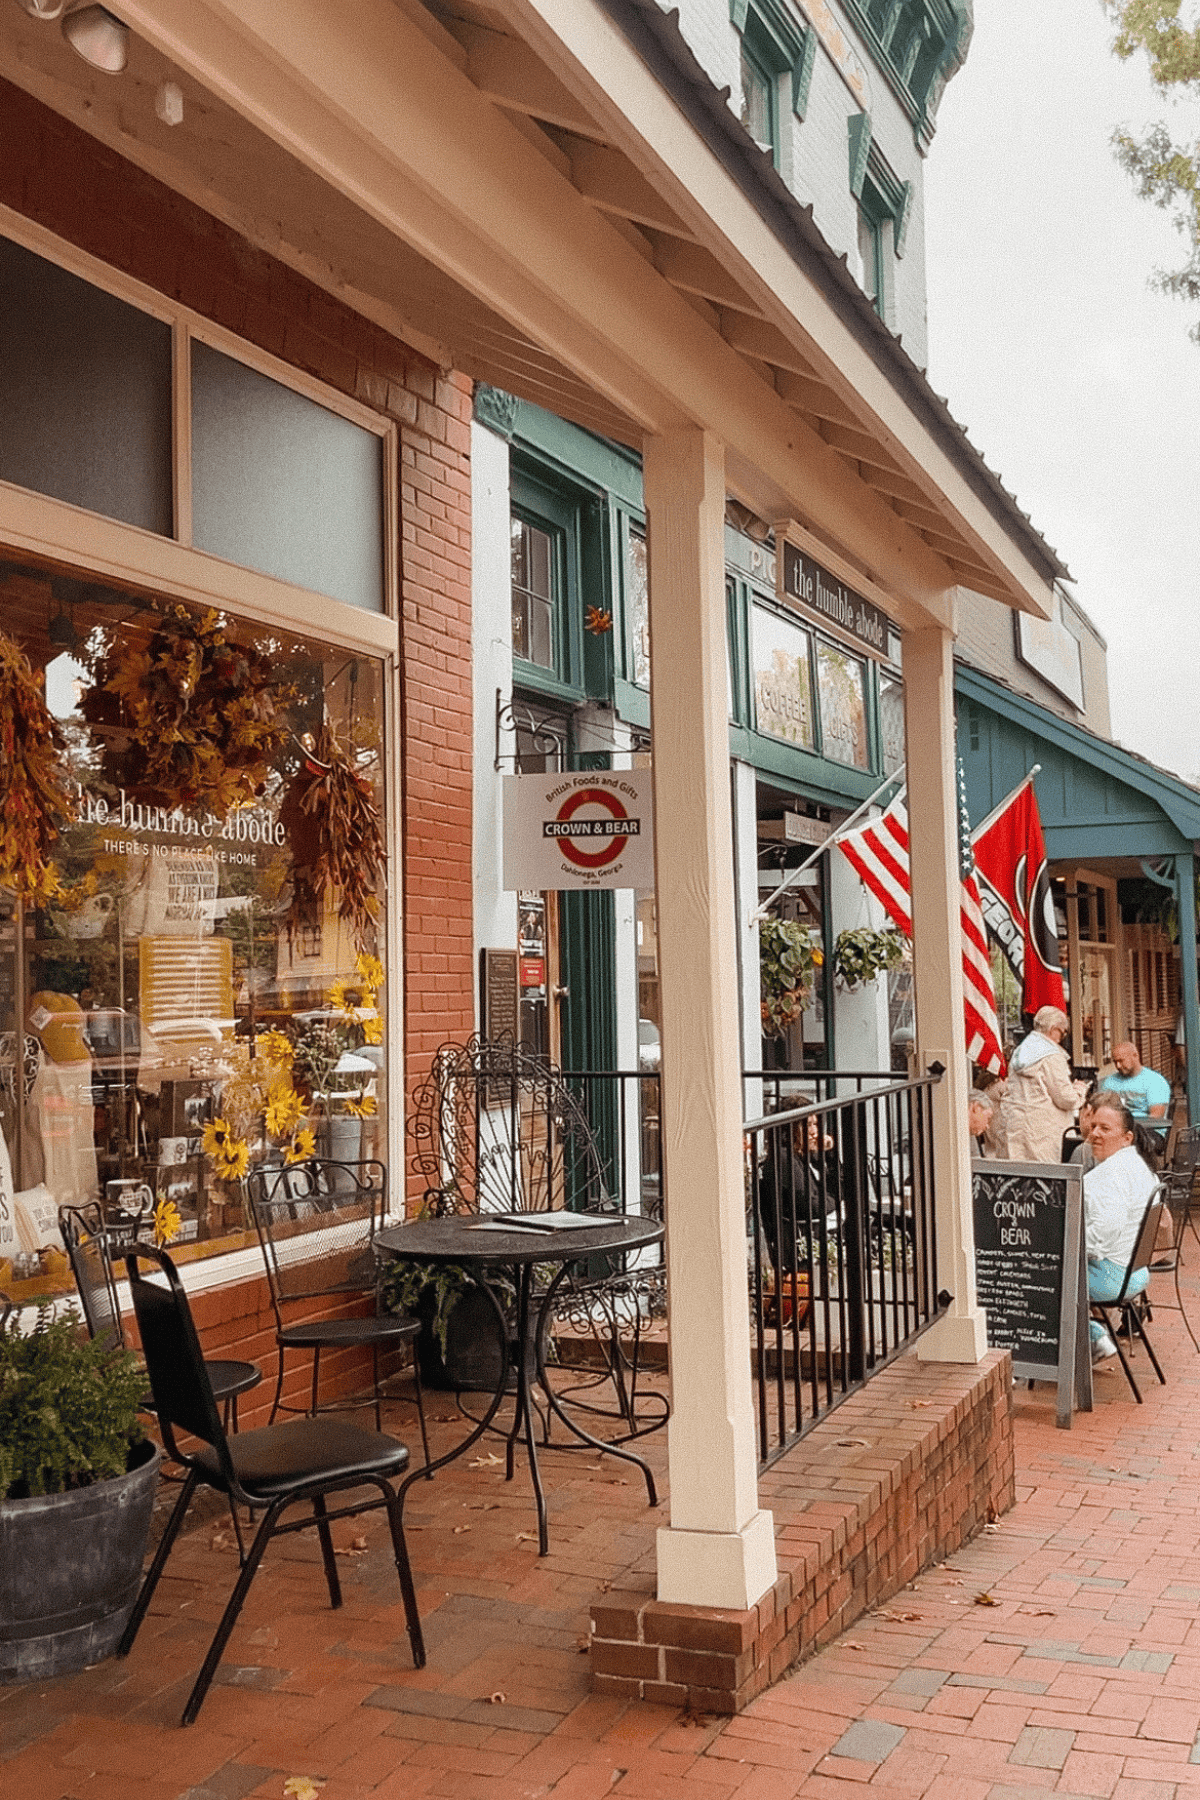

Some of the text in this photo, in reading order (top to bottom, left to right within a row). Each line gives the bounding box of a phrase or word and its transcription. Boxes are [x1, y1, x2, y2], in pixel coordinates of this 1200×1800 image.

[793, 558, 883, 648] the humble abode
[545, 775, 639, 803] British Foods and Gifts
[221, 804, 285, 846] abode
[545, 821, 639, 835] CROWN & BEAR
[104, 839, 149, 855] THERE'S
[153, 844, 168, 857] NO
[229, 852, 257, 866] HOME
[980, 887, 1024, 979] GEOR
[993, 1201, 1036, 1219] CROWN
[1000, 1228, 1032, 1246] BEAR
